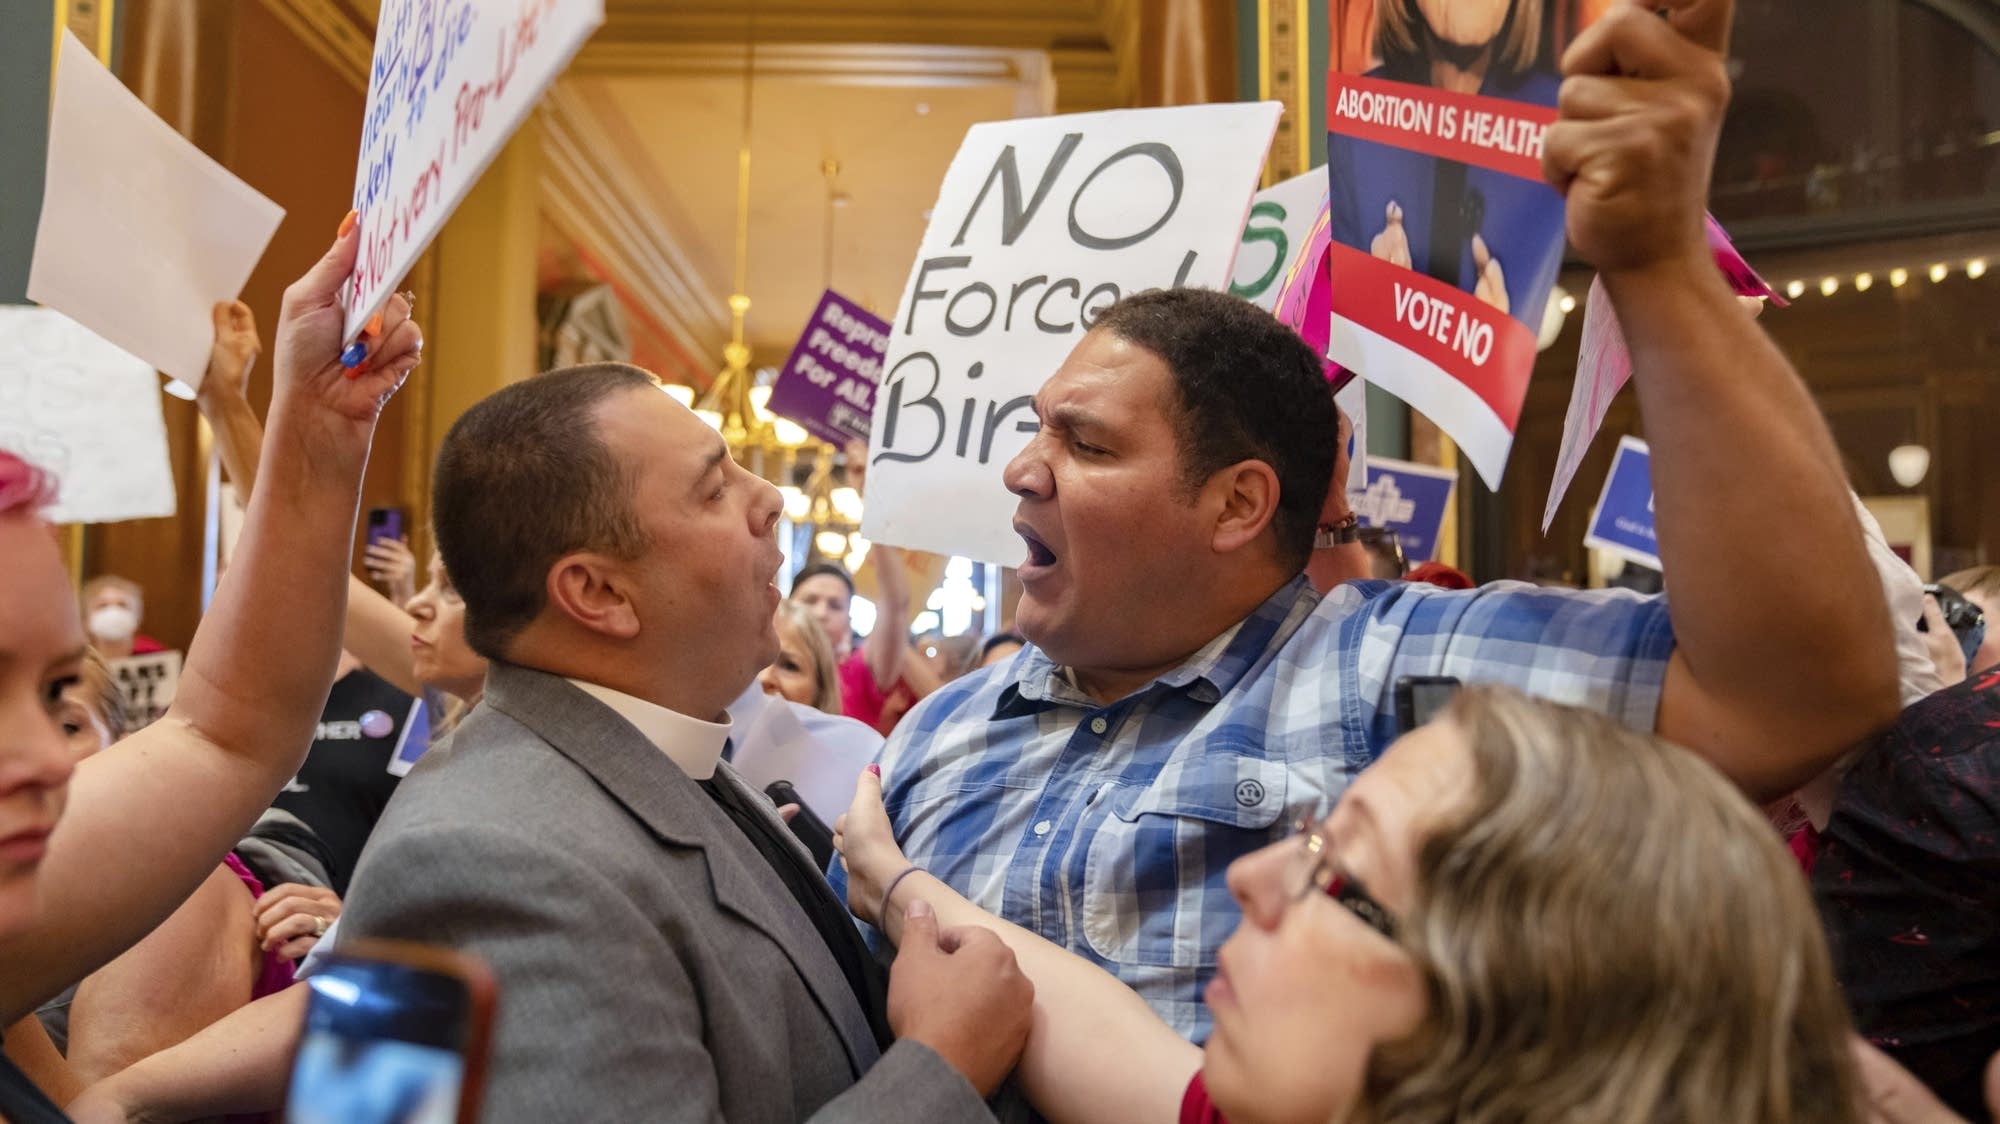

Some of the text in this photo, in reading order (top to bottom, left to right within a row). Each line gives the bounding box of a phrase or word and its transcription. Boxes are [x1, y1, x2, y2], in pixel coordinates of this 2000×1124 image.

[407, 84, 427, 139] to
[1335, 86, 1547, 159] ABORTION IS HEALTH
[402, 137, 447, 243] very
[950, 132, 1184, 250] NO
[904, 249, 1198, 338] Force
[1394, 282, 1494, 367] VOTE NO
[794, 353, 838, 389] For
[872, 350, 1042, 464] Bir
